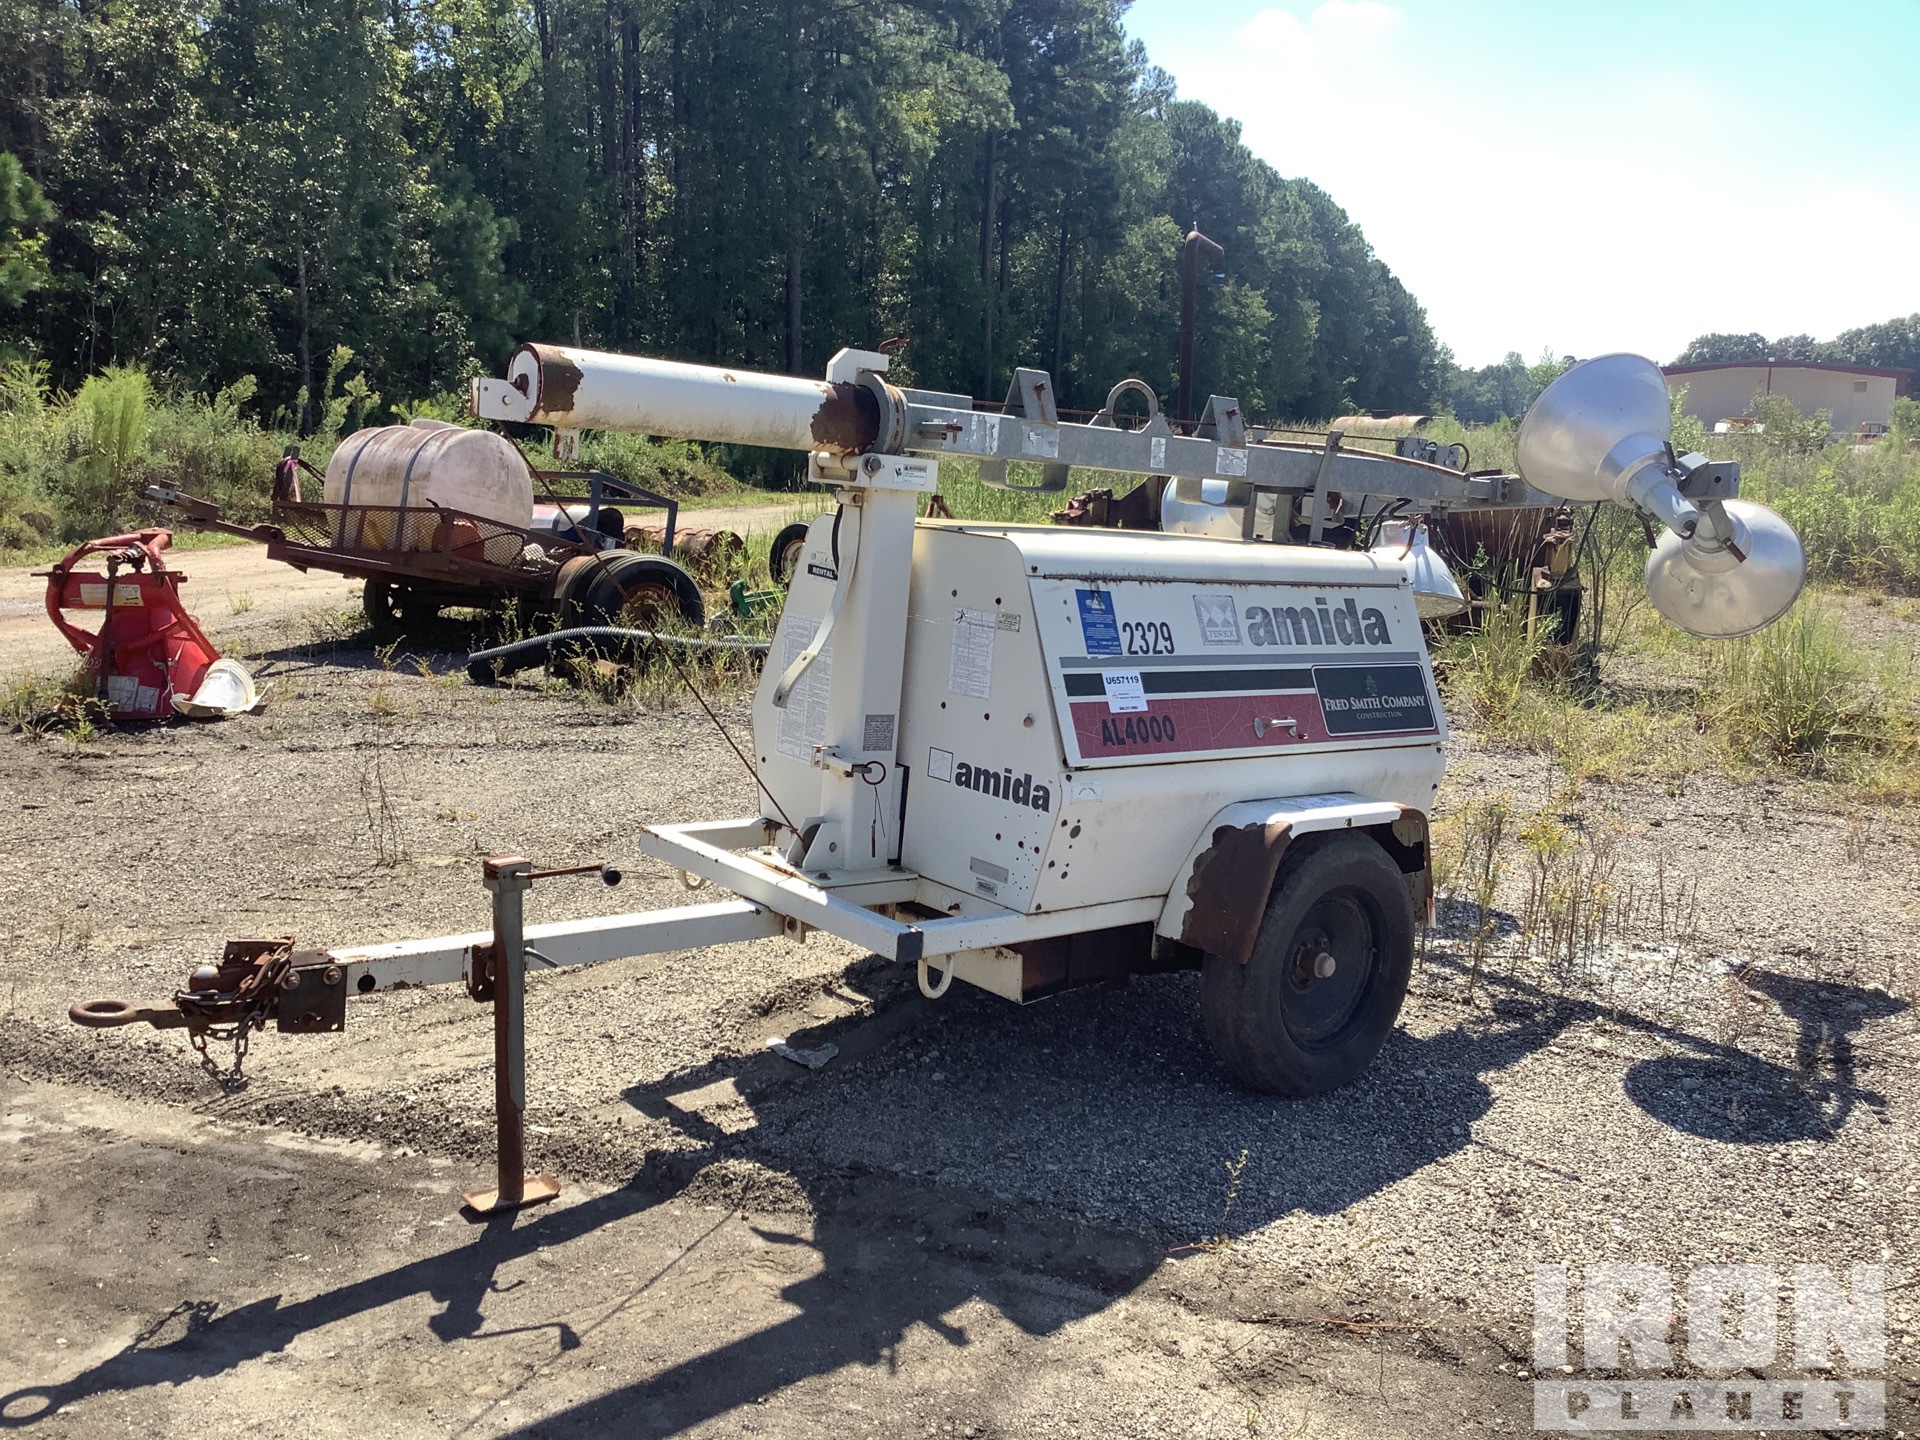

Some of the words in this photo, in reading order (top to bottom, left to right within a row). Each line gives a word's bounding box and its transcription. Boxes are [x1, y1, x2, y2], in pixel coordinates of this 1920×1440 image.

[812, 566, 834, 578] RENTAL
[1245, 597, 1392, 647] amida
[1122, 621, 1175, 655] 2329
[1207, 629, 1236, 639] TEREX
[1105, 675, 1140, 685] U657119
[1323, 697, 1349, 711] FRED
[1350, 696, 1381, 710] SMITH
[1381, 695, 1425, 708] COMPANY
[1356, 711, 1403, 720] CONSTRUCTION
[1101, 714, 1176, 746] AL4000
[954, 762, 1050, 813] amida
